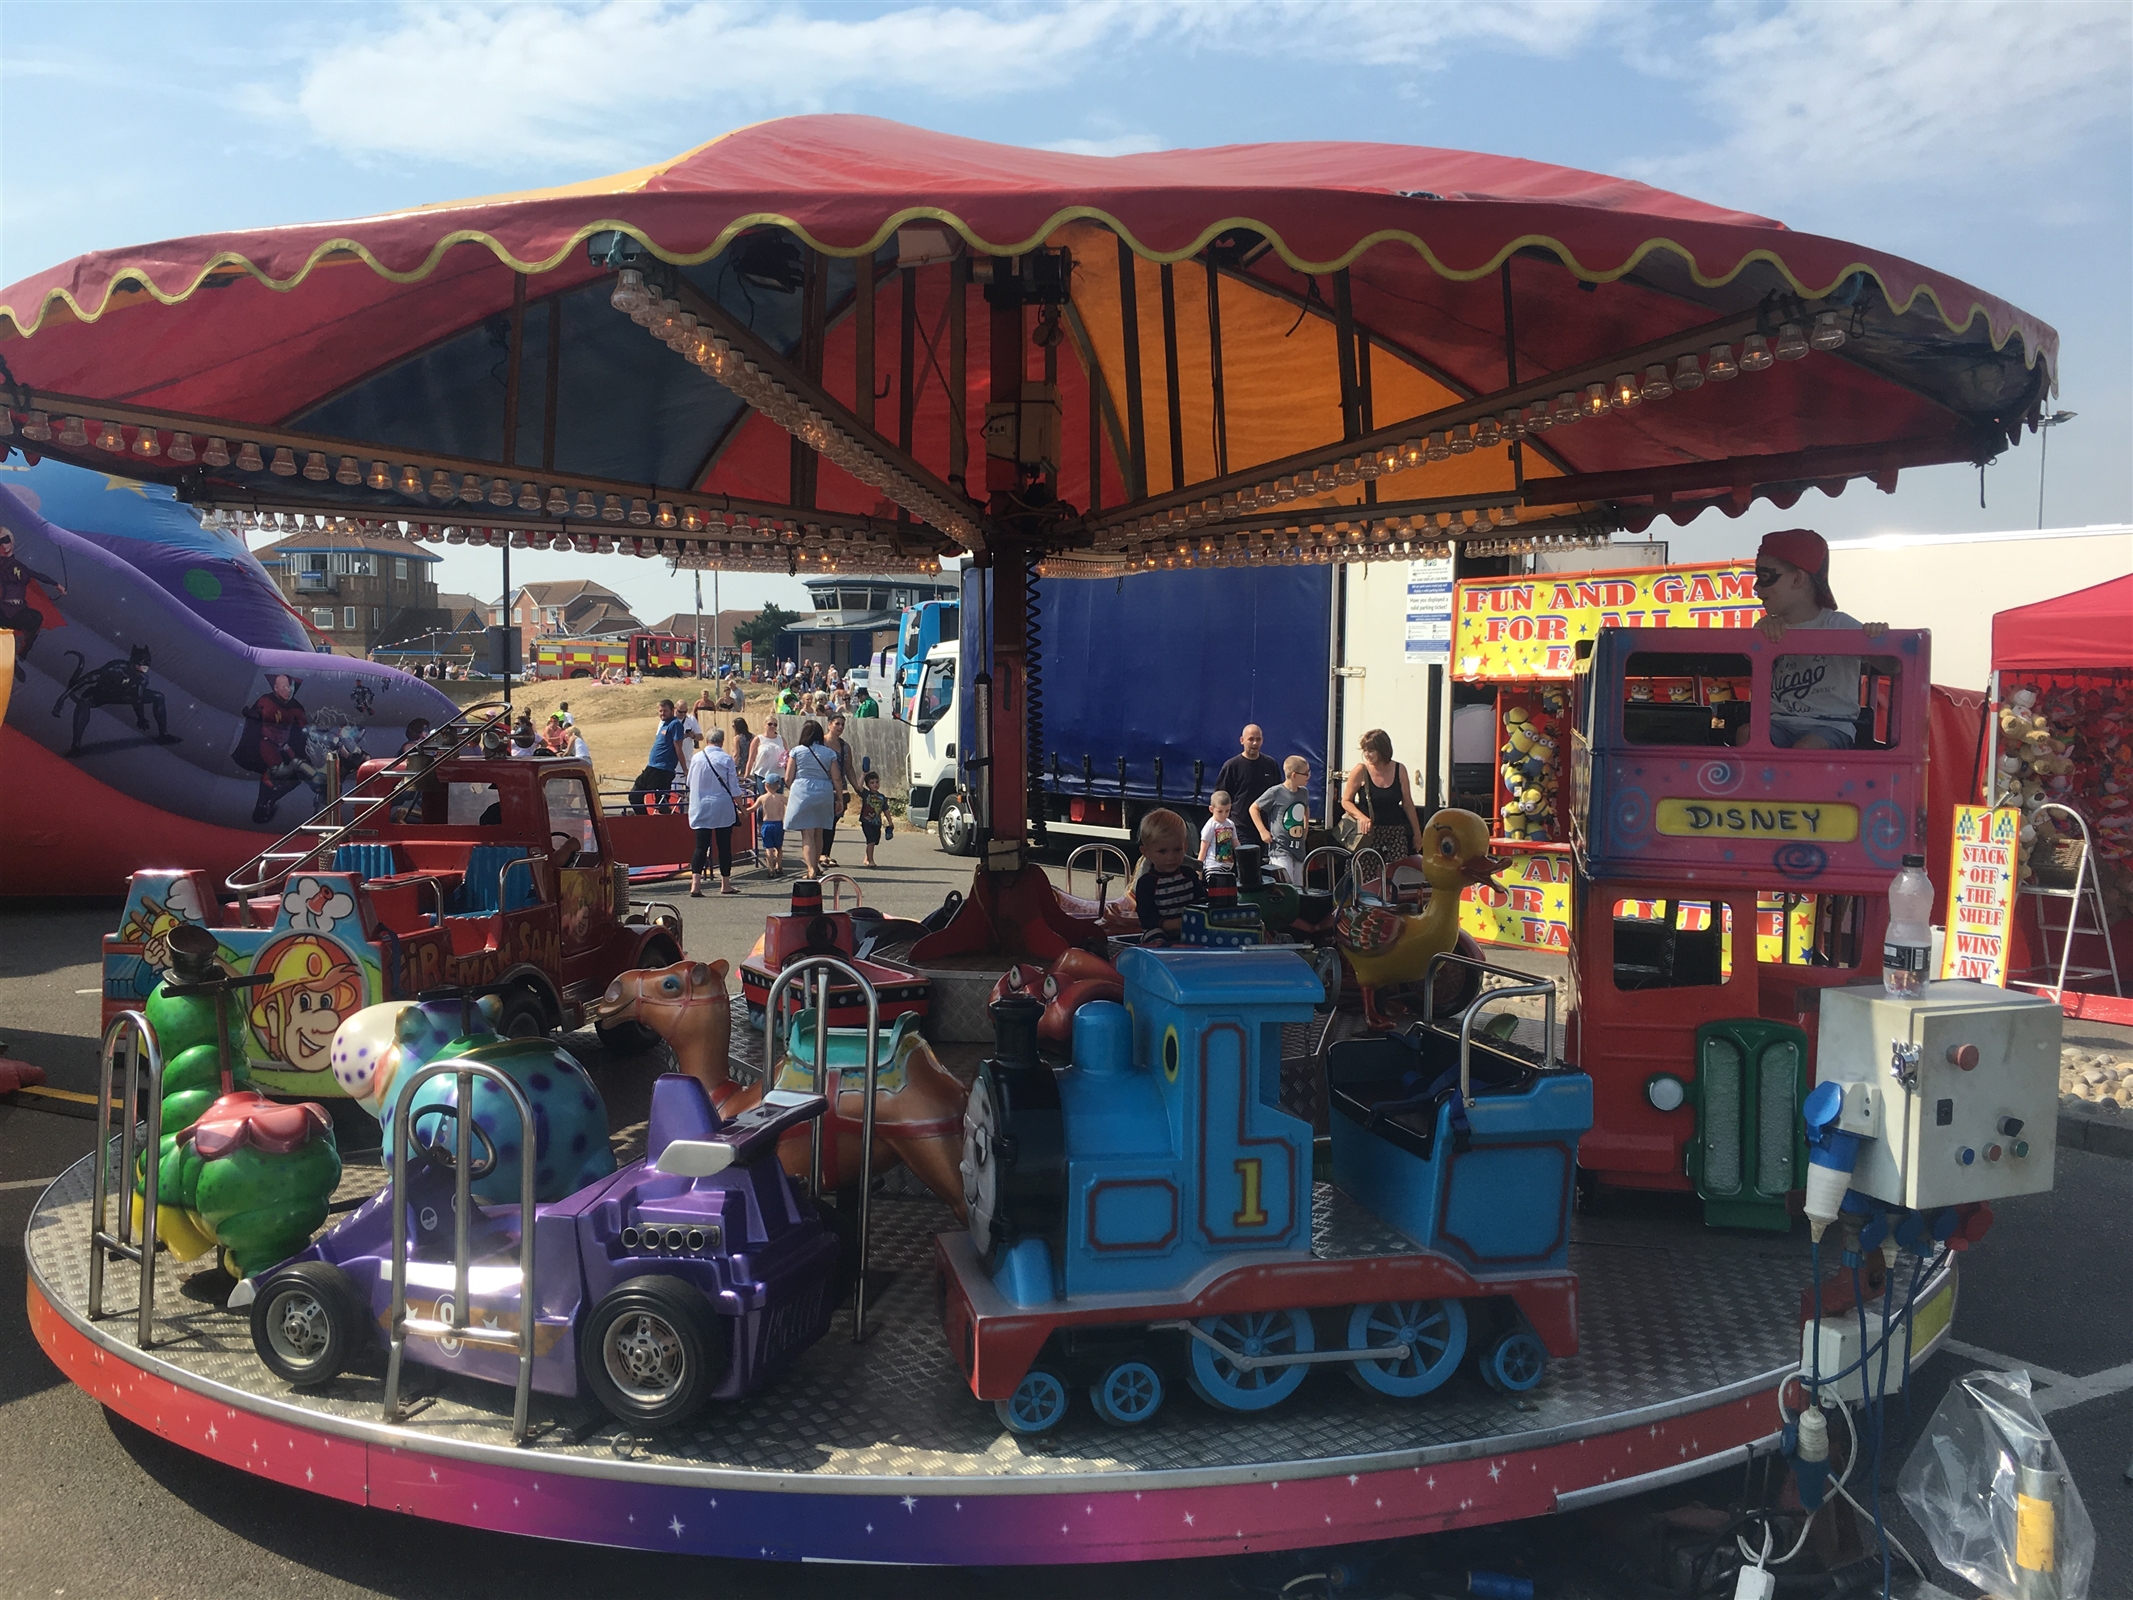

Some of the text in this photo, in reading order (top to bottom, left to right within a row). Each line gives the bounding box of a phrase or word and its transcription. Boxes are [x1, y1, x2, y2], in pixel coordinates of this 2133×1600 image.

[1463, 571, 1758, 613] FUN AND GAM
[1485, 615, 1568, 642] FOR
[1685, 806, 1820, 833] DISNEY
[1977, 811, 1994, 844] 1
[1962, 845, 2008, 865] STACK
[1970, 866, 1998, 885] OFF
[1965, 885, 1995, 905] THE
[1959, 905, 2003, 926] SHELF
[1521, 917, 1570, 947] FA
[1957, 931, 2001, 957] WINS
[519, 921, 562, 973] SAM
[1957, 956, 1995, 980] ANY
[1234, 1159, 1267, 1226] 1
